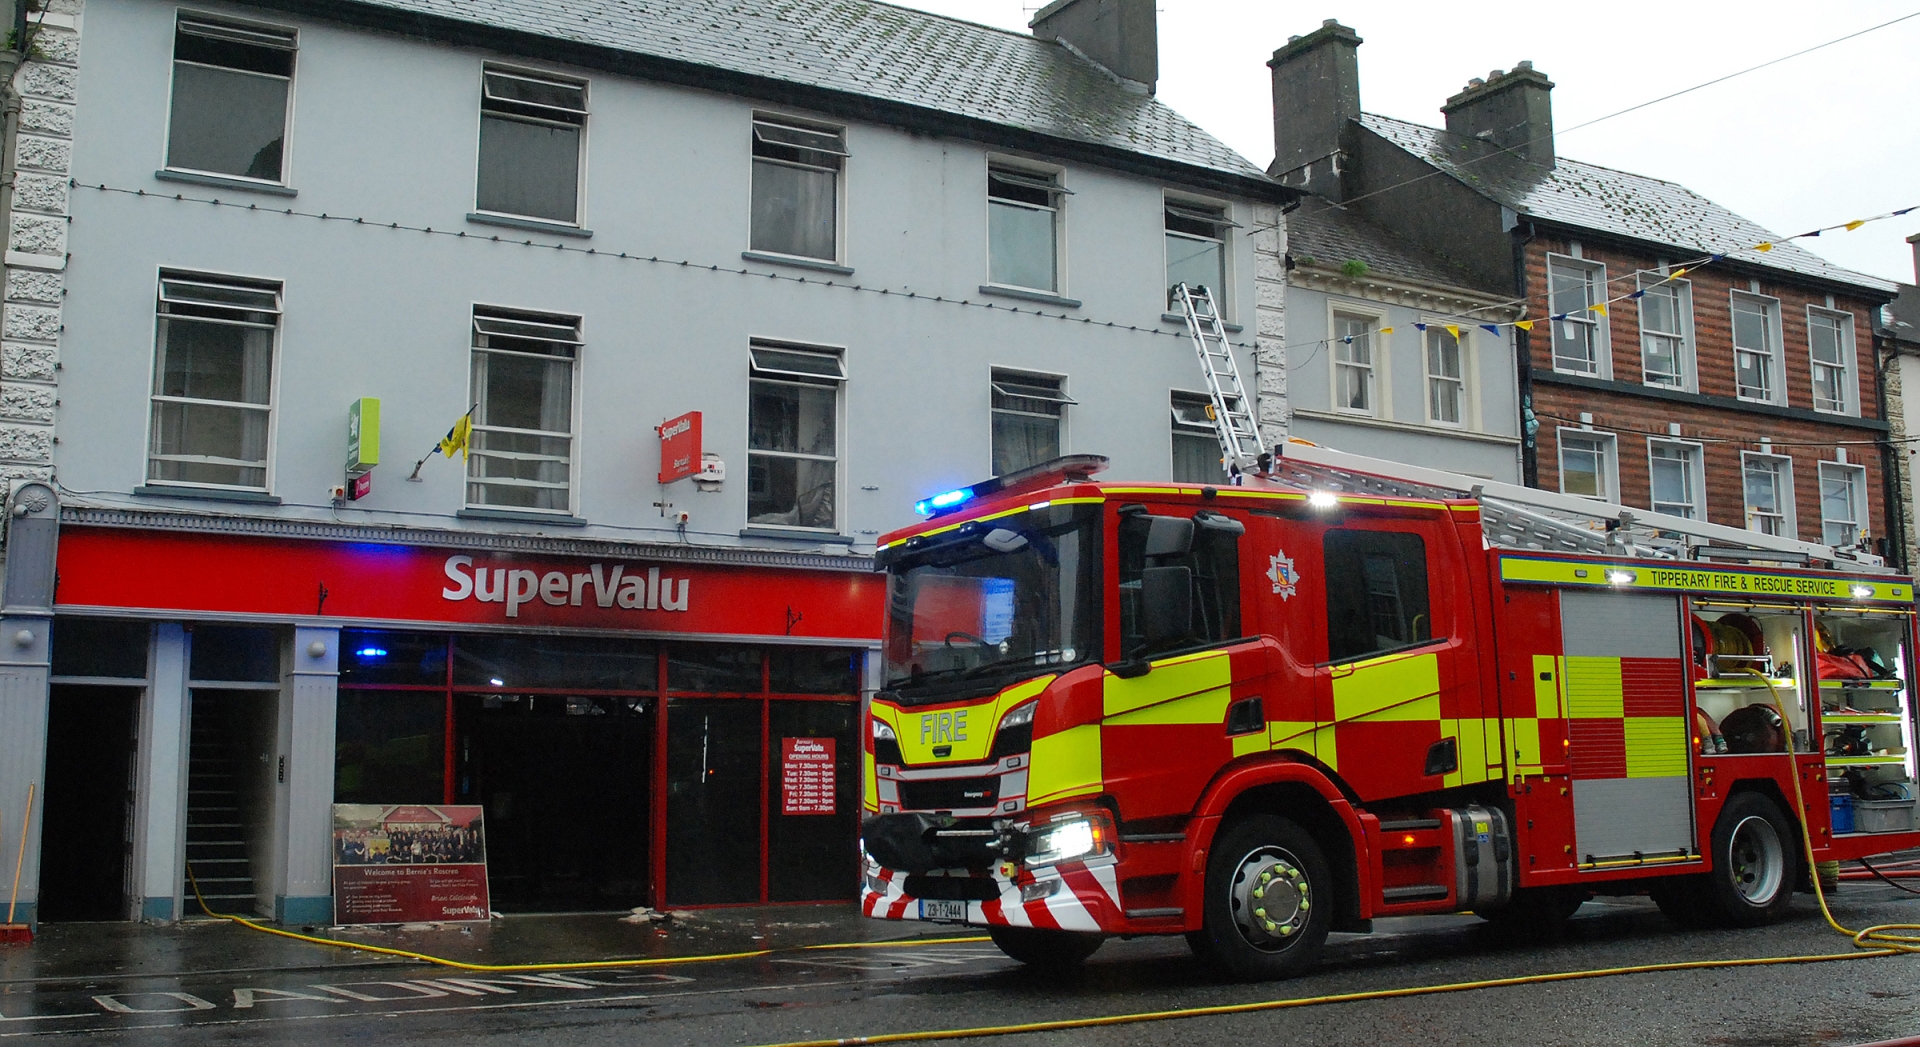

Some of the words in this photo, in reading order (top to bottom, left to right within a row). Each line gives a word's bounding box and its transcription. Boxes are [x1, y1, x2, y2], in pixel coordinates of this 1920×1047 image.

[661, 418, 690, 441] SuperValu
[442, 555, 690, 618] SuperValu
[1651, 571, 1711, 588] TIPPERARY
[1714, 574, 1737, 590] FIRE
[1740, 577, 1748, 590] &
[1754, 577, 1793, 593] RESCUE
[1796, 580, 1836, 595] SERVICE
[920, 710, 968, 745] FIRE
[794, 744, 824, 753] SuperValu
[442, 905, 480, 916] SuperValu
[927, 903, 961, 918] 23-T-2444
